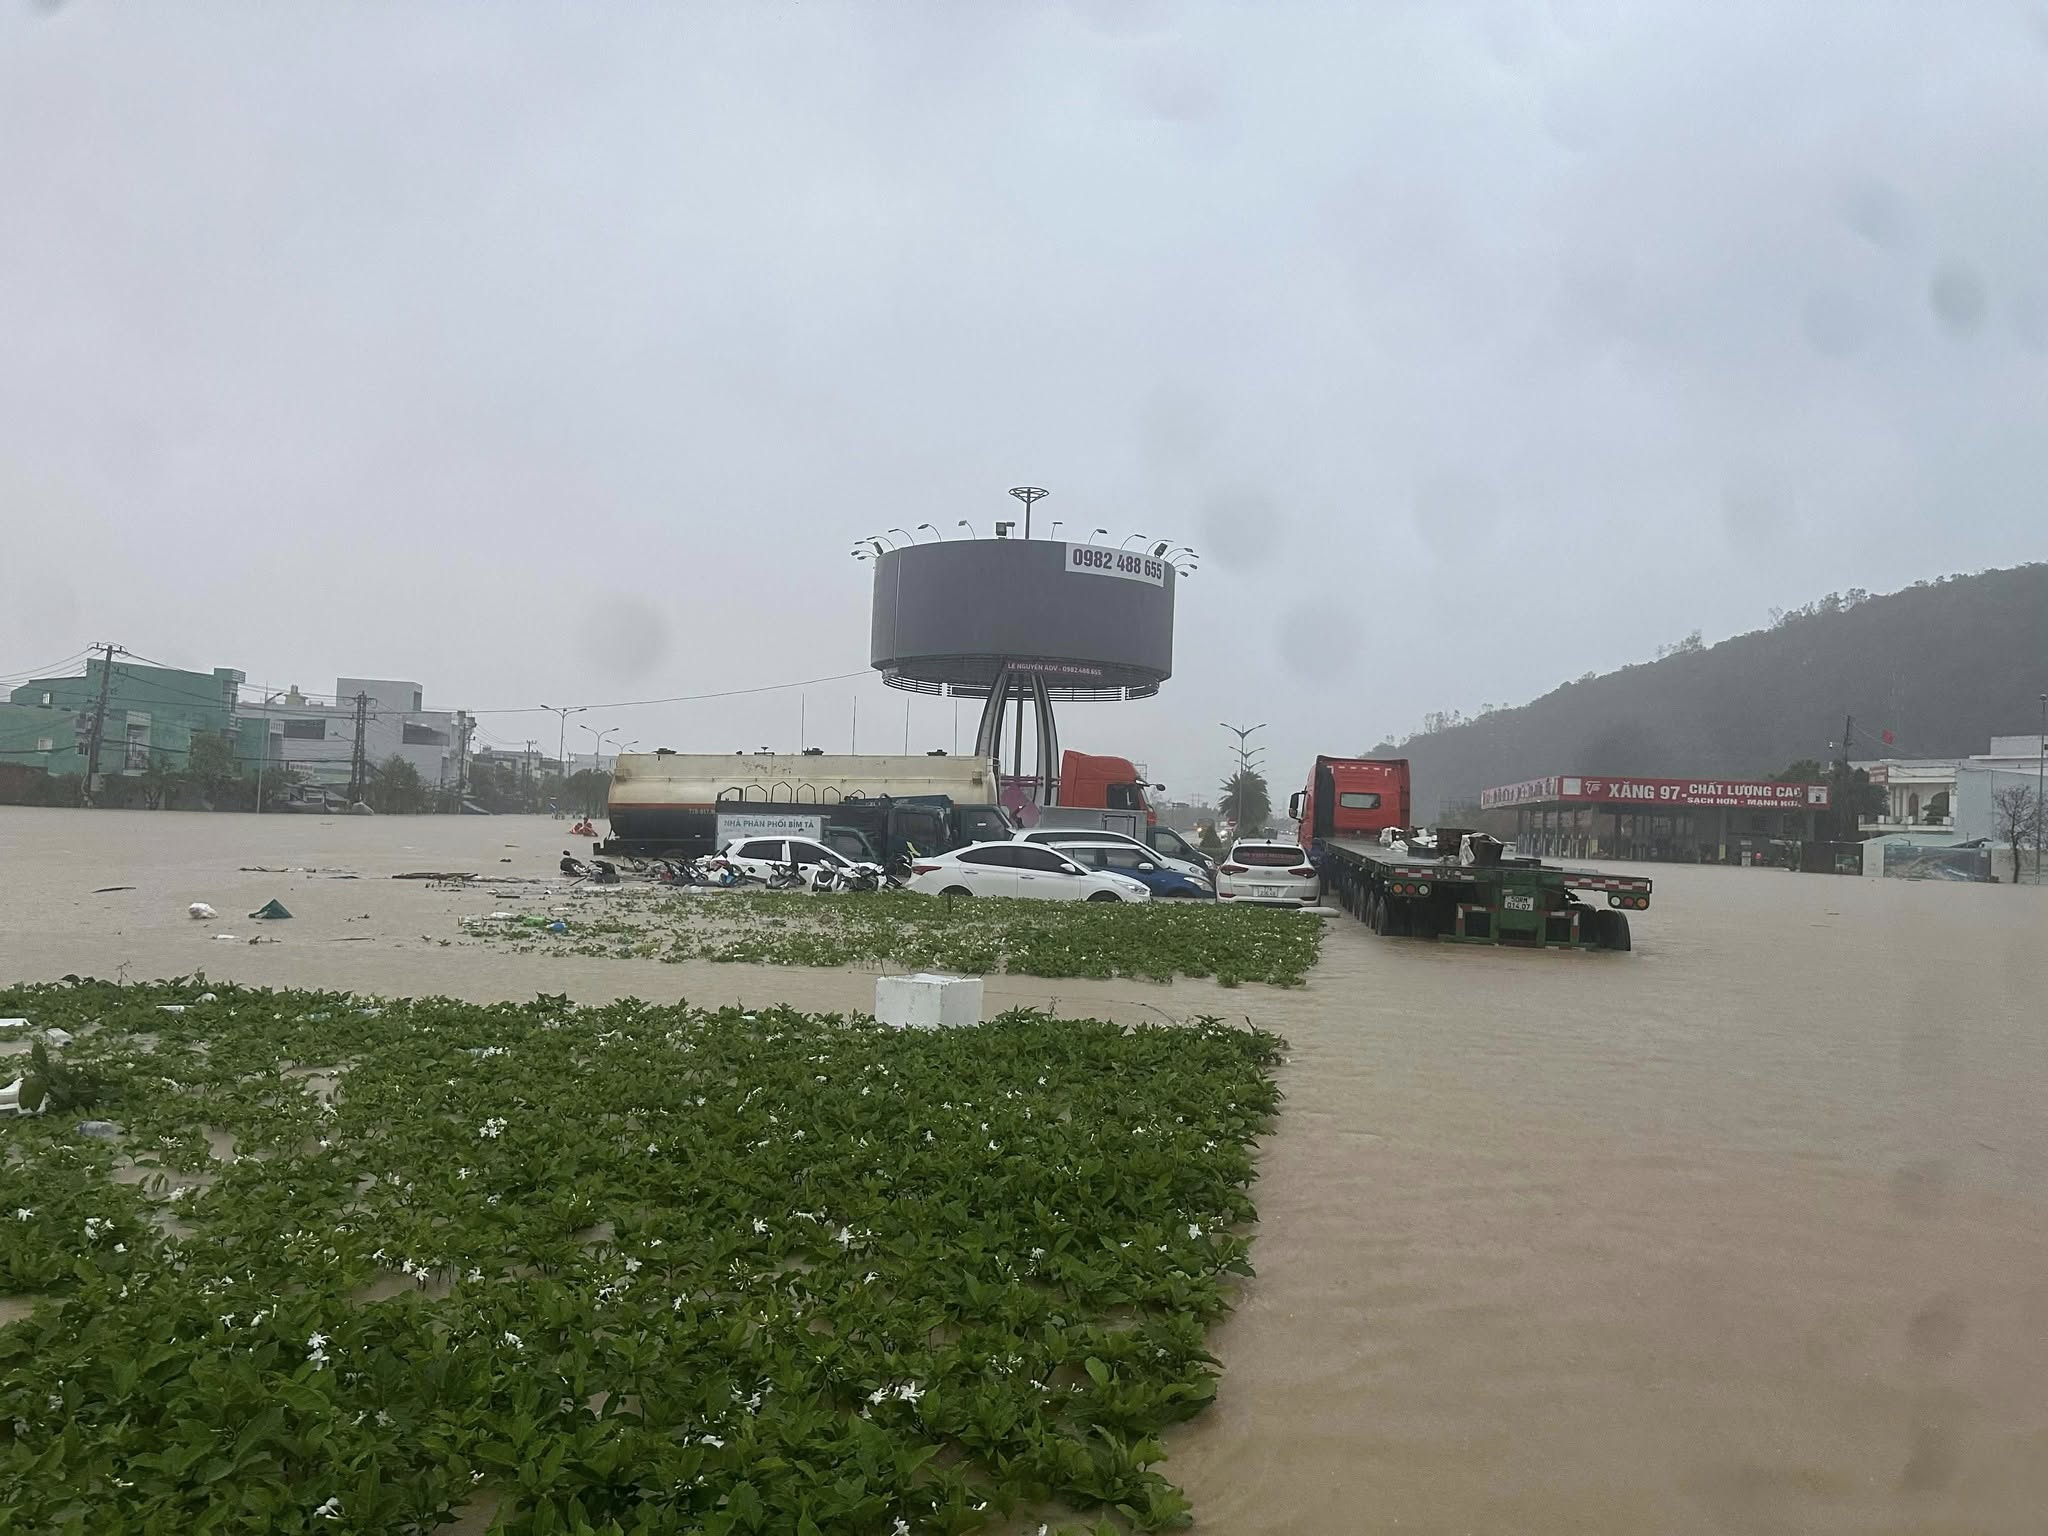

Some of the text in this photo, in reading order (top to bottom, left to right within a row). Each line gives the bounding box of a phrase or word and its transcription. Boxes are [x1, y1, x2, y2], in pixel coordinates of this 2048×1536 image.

[1072, 548, 1162, 580] 0982 488 655
[1608, 780, 1655, 800] XĂNG
[1689, 781, 1723, 795] CHẤT
[1727, 784, 1772, 798] LƯỢNG
[1687, 797, 1714, 806] SẠCH
[1747, 799, 1778, 807] MẠNH
[724, 818, 742, 828] NHÀ
[743, 818, 765, 828] PHÂN
[767, 817, 787, 828] PHỐI
